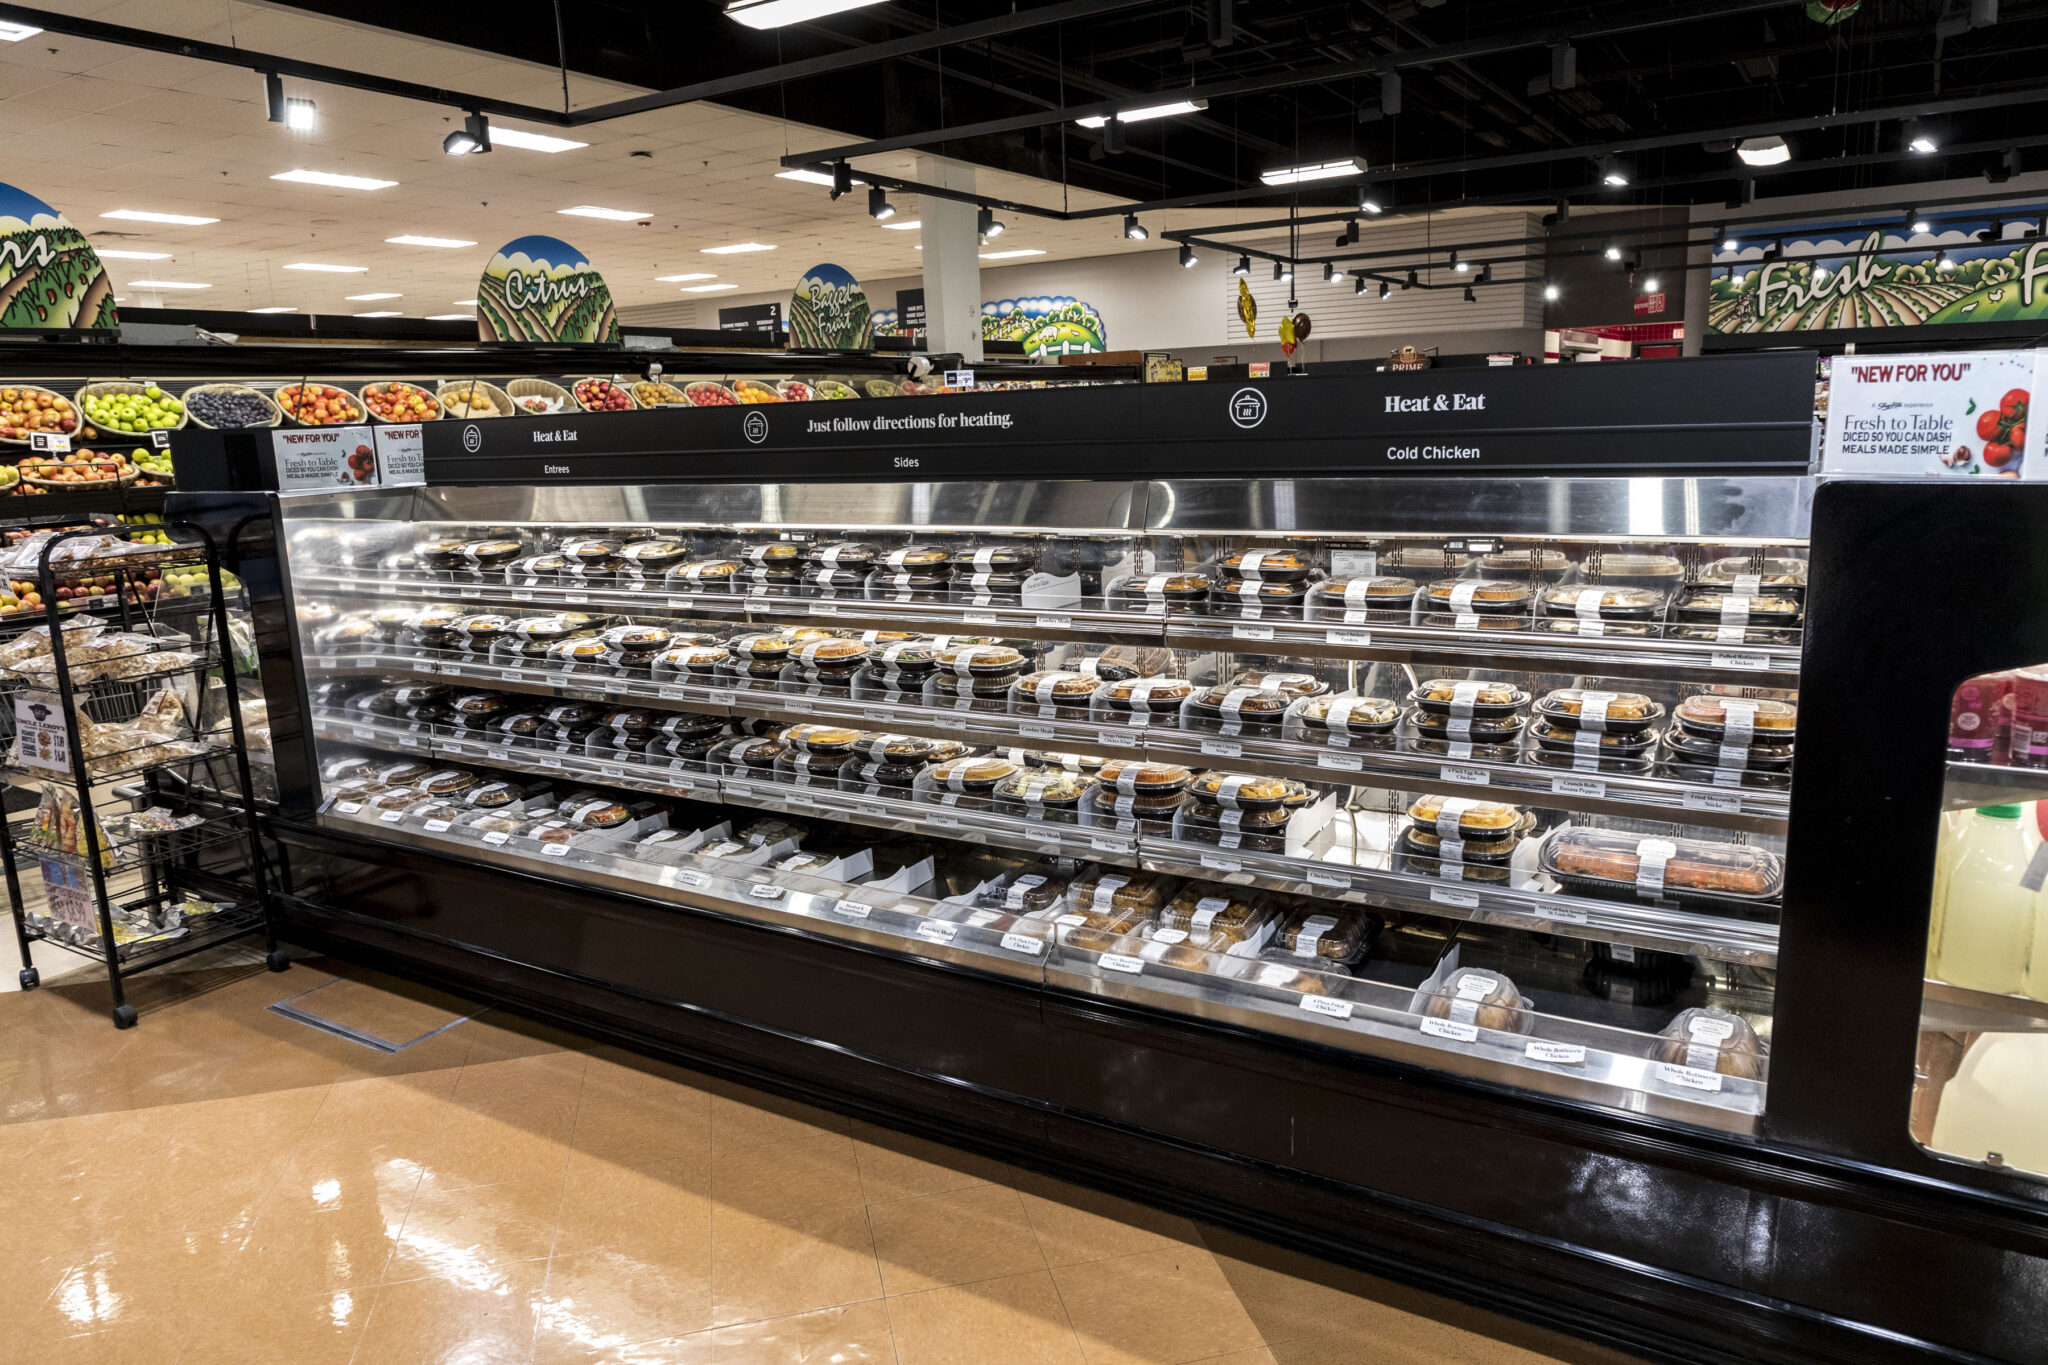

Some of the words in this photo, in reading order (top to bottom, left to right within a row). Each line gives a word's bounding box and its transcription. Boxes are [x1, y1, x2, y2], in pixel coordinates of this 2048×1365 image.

[1759, 230, 1892, 318] Fresh
[505, 270, 589, 310] Citrus
[809, 281, 852, 317] Bagged
[770, 305, 777, 316] 2
[818, 310, 852, 339] Fruit
[1851, 365, 1894, 384] "NEW
[1895, 364, 1928, 382] FOR
[1931, 362, 1972, 382] YOU"
[1384, 395, 1431, 413] Heat
[1433, 394, 1449, 412] &
[1452, 393, 1486, 411] Eat
[806, 419, 831, 433] Just
[833, 416, 872, 432] follow
[872, 415, 937, 431] directions
[937, 413, 958, 429] for
[959, 411, 1014, 430] heating.
[1844, 414, 1886, 431] Fresh
[1891, 416, 1907, 431] to
[1907, 414, 1954, 430] Table
[282, 434, 304, 444] "NEW
[305, 433, 321, 443] FOR
[321, 432, 341, 443] YOU"
[384, 430, 405, 440] "NEW
[405, 429, 420, 439] FOR
[533, 431, 554, 442] Heat
[554, 430, 562, 441] &
[563, 429, 578, 441] Eat
[1843, 432, 1870, 442] DICED
[1871, 432, 1884, 442] SO
[1885, 432, 1904, 442] YOU
[1904, 432, 1926, 442] CAN
[1926, 432, 1953, 442] DASH
[1387, 446, 1418, 460] Cold
[1422, 445, 1481, 460] Chicken
[1842, 444, 1877, 454] MEALS
[1878, 444, 1909, 454] MADE
[1910, 444, 1950, 454] SIMPLE
[285, 458, 307, 467] Fresh
[308, 459, 317, 467] to
[317, 457, 338, 466] Table
[387, 454, 408, 463] Fresh
[408, 455, 417, 463] to
[893, 457, 920, 468] Sides
[544, 465, 570, 474] Entrees
[1559, 785, 1578, 793] Banana
[1578, 787, 1601, 795] Peppers
[1013, 942, 1029, 950] Chicken
[1315, 1004, 1337, 1012] Chicken
[1429, 1020, 1446, 1028] Whole
[1447, 1023, 1475, 1034] Rotisserie
[1438, 1027, 1462, 1037] Chicken
[1534, 1045, 1552, 1053] Whole
[1664, 1066, 1684, 1074] Whole
[1685, 1070, 1718, 1081] Rotisserie
[1677, 1074, 1704, 1085] Chicken
